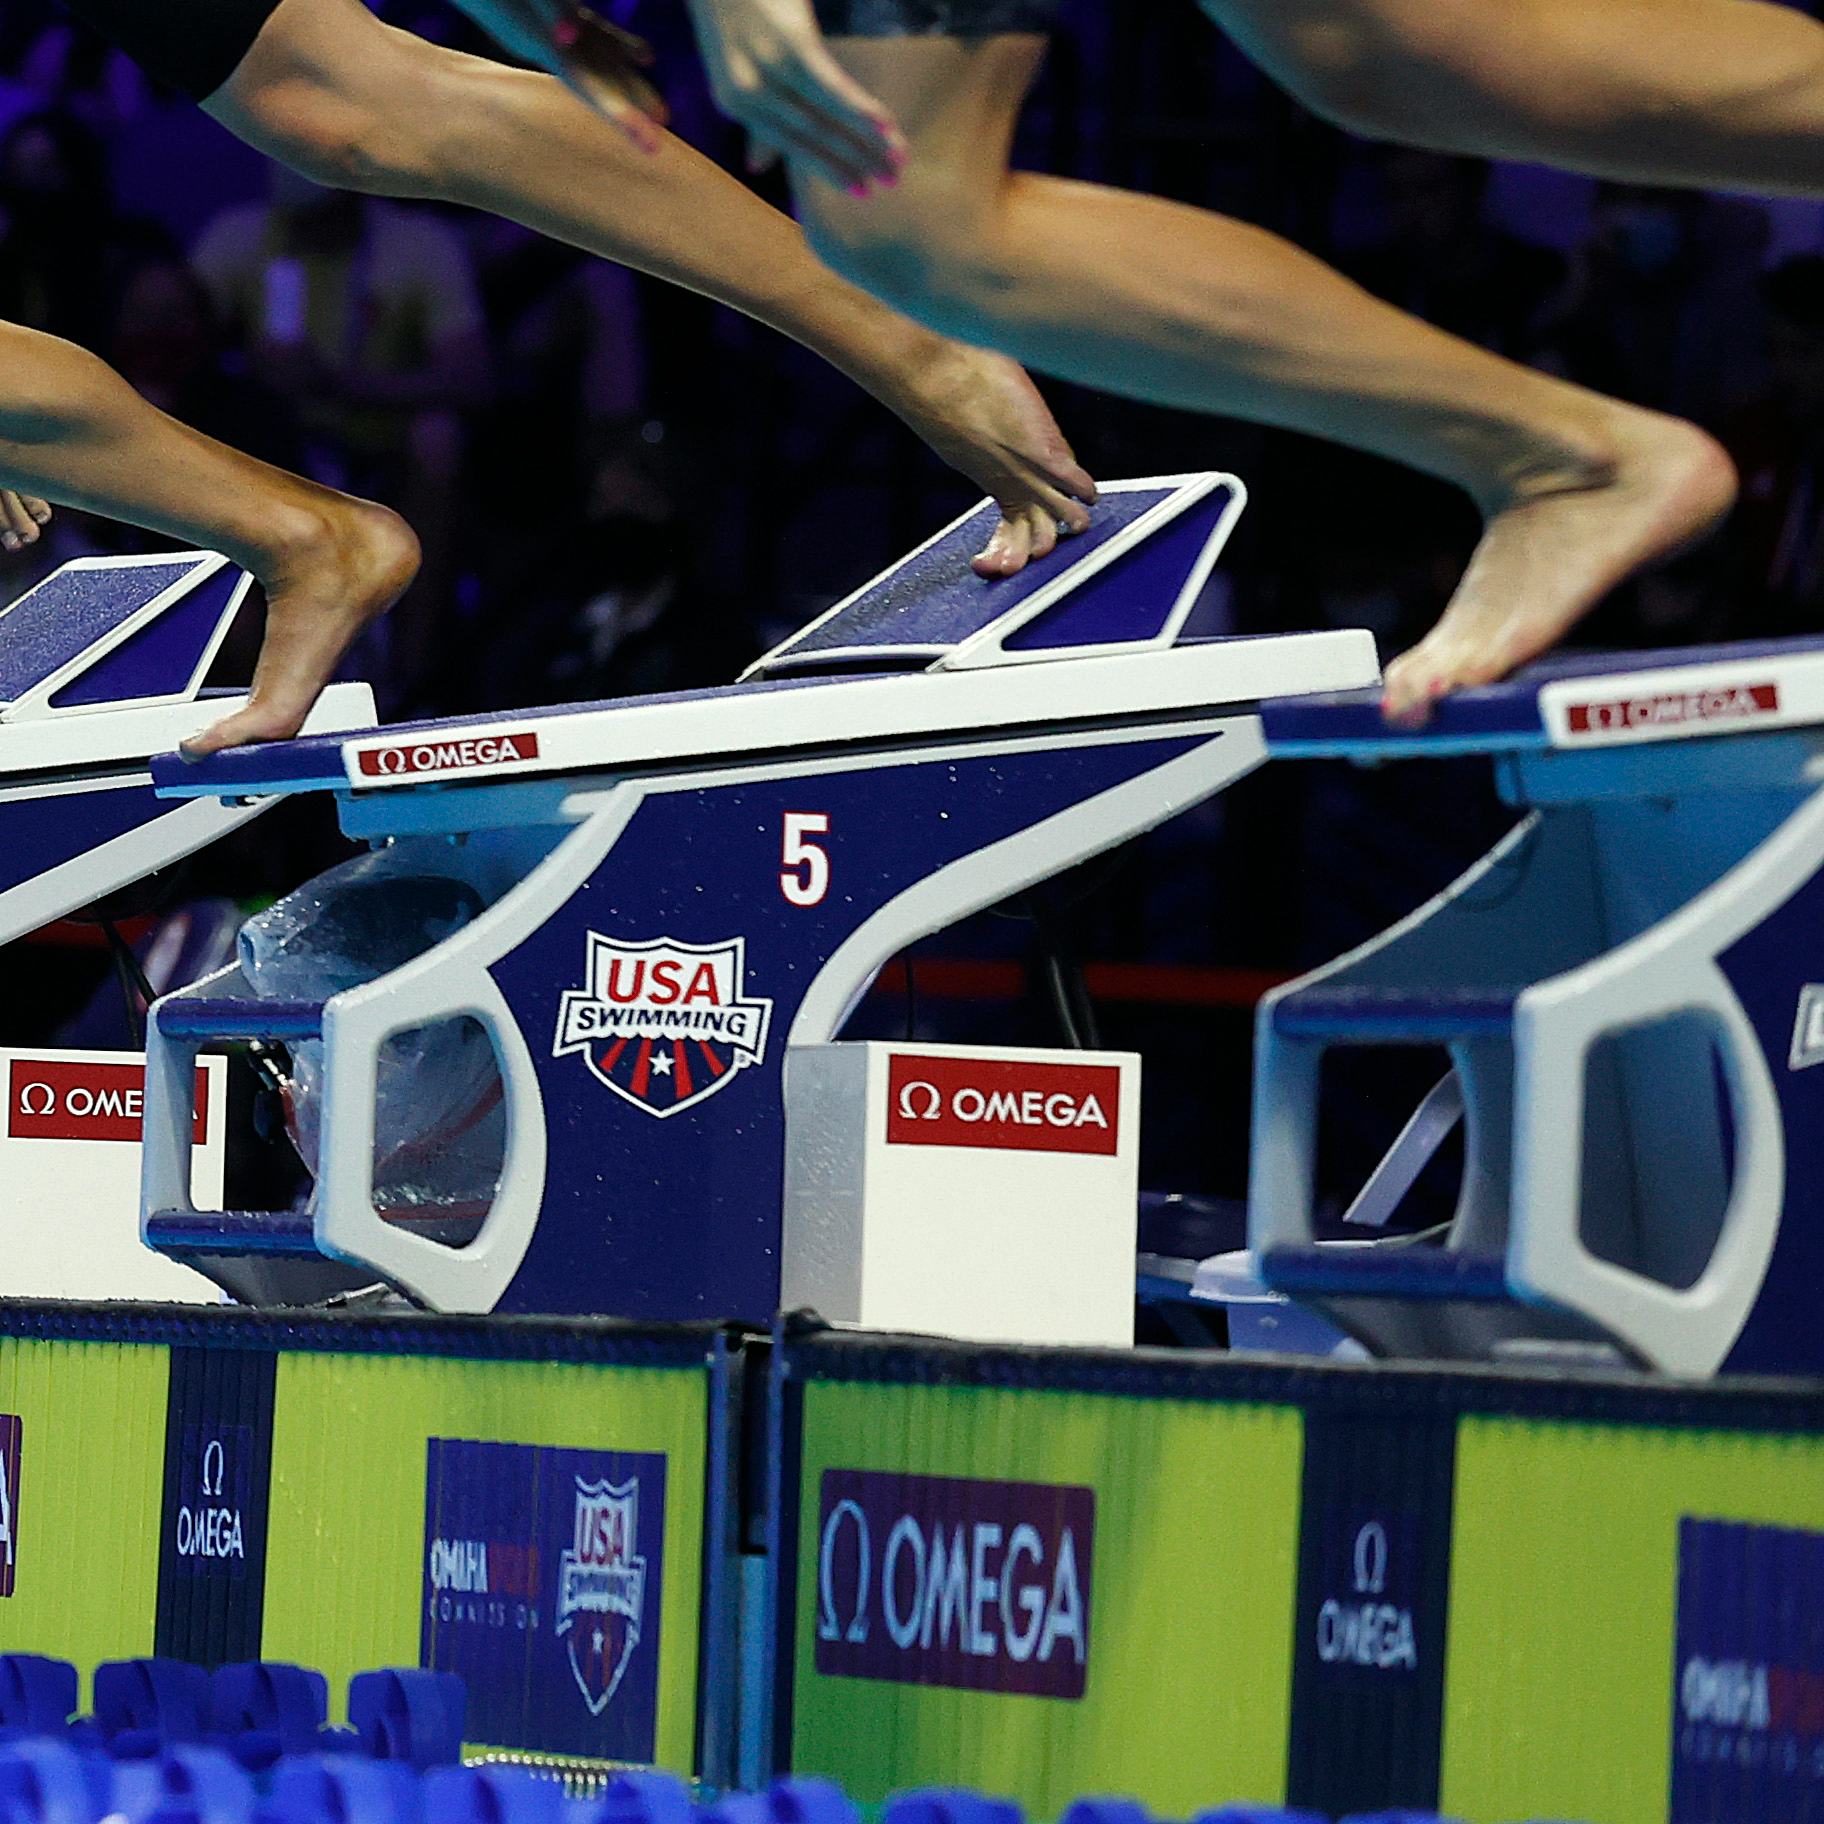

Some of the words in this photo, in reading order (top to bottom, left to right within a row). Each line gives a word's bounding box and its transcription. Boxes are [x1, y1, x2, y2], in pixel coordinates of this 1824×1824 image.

[412, 737, 521, 770] OMEGA
[779, 811, 831, 908] 5
[607, 959, 720, 1006] USA
[577, 1006, 748, 1038] SWIMMING
[952, 1088, 1108, 1129] OMEGA
[177, 1505, 245, 1560] OMEGA
[580, 1506, 625, 1565] USA
[882, 1515, 1085, 1666] OMEGA
[1316, 1598, 1417, 1671] OMEGA
